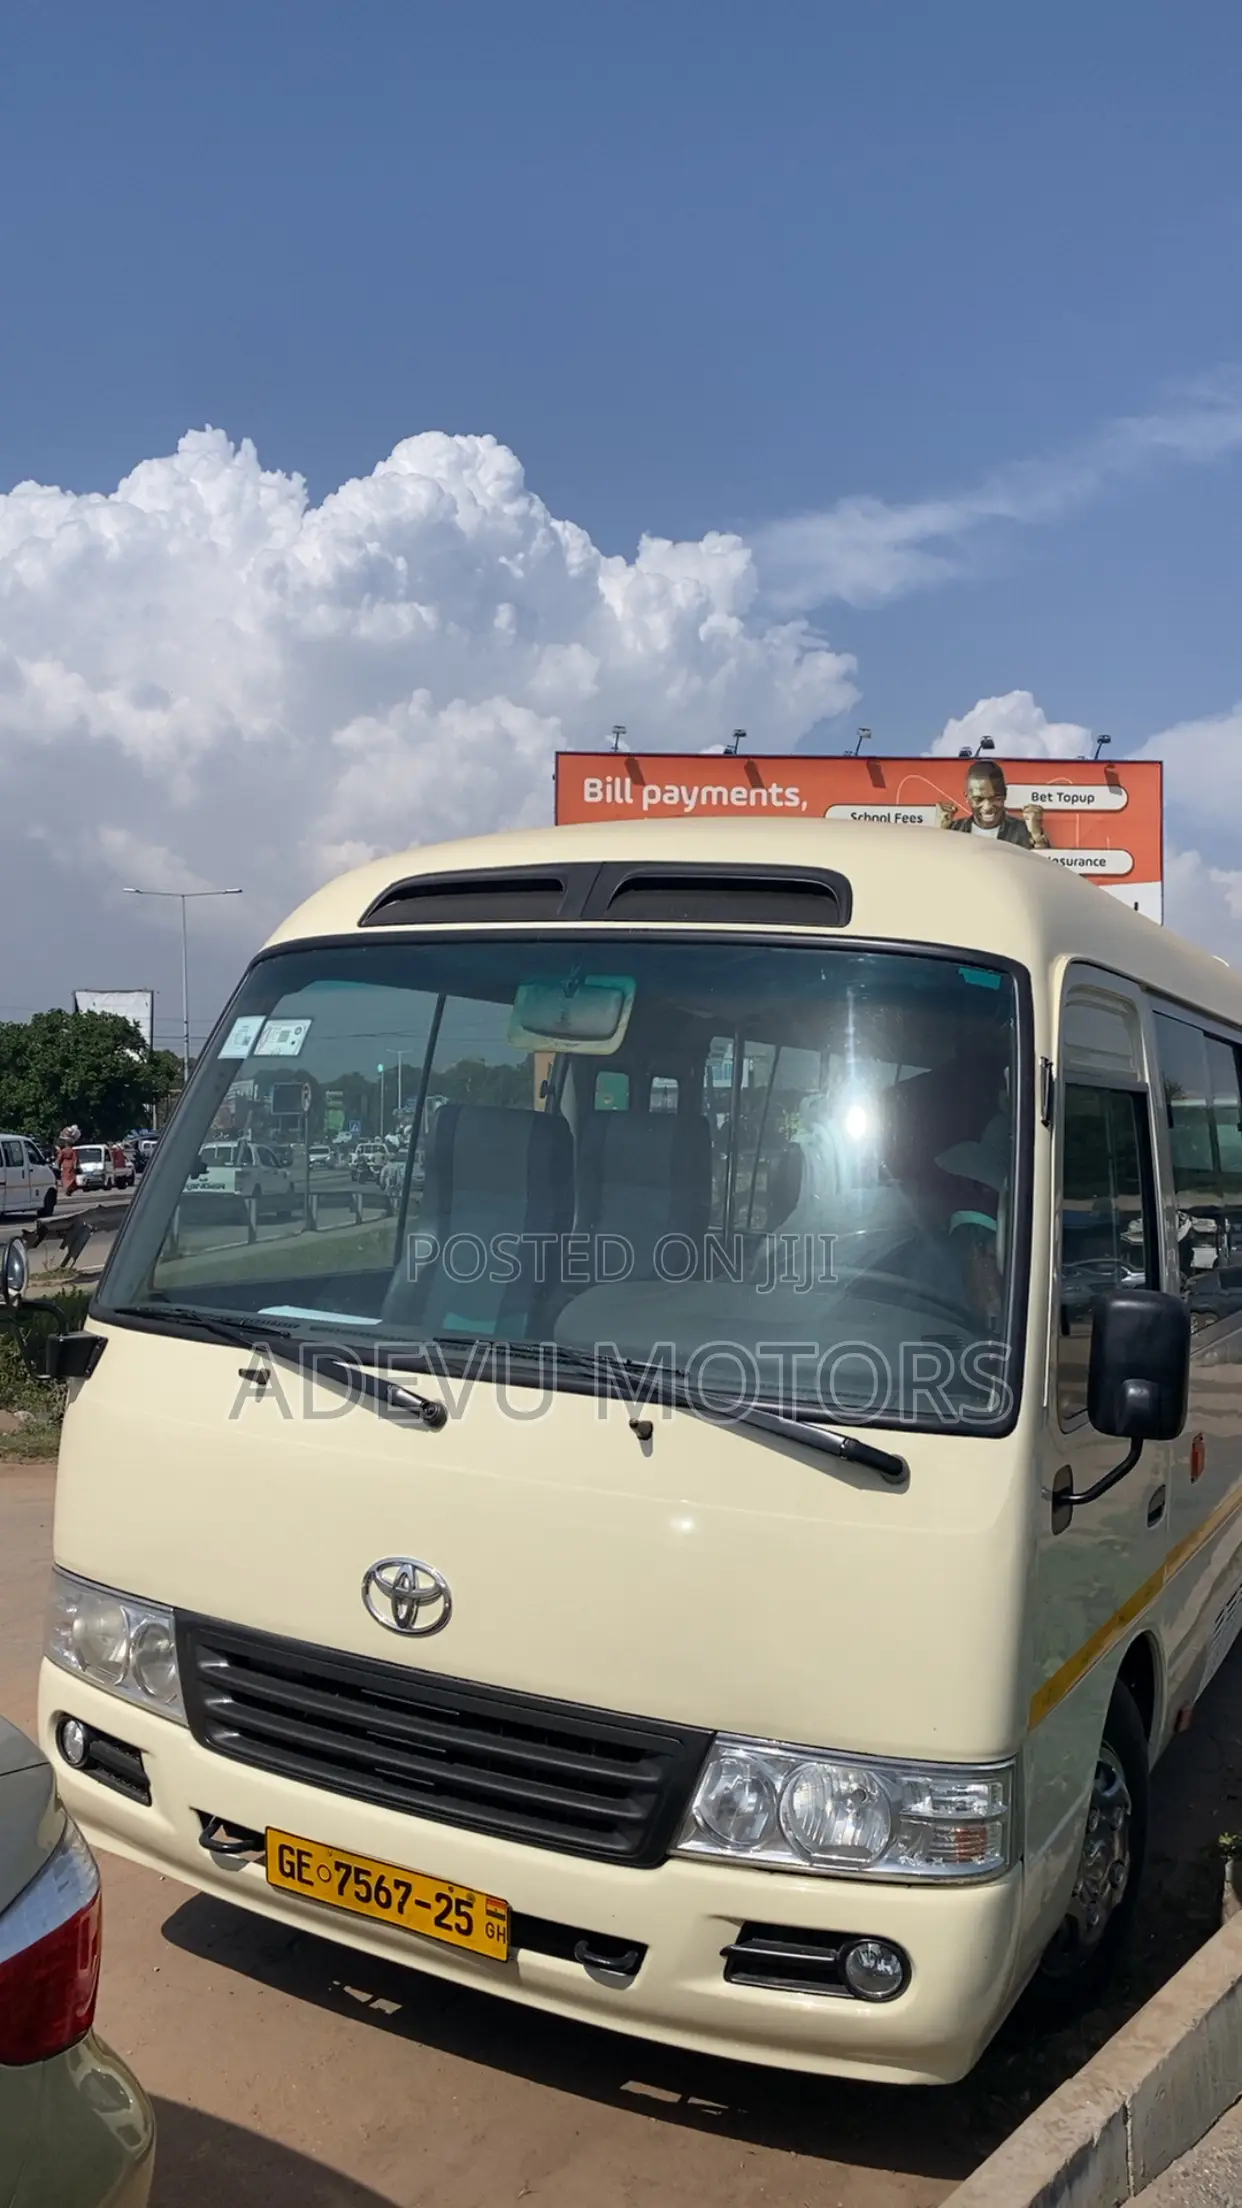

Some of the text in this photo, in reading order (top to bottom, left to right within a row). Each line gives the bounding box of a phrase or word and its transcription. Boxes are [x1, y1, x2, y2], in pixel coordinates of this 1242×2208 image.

[583, 776, 808, 812] Bill payments,
[1031, 791, 1095, 805] Bet Topup
[851, 812, 924, 824] School Fees
[1048, 856, 1106, 868] nsurance
[278, 1844, 474, 1937] GE 7567-25
[485, 1922, 507, 1945] GH
